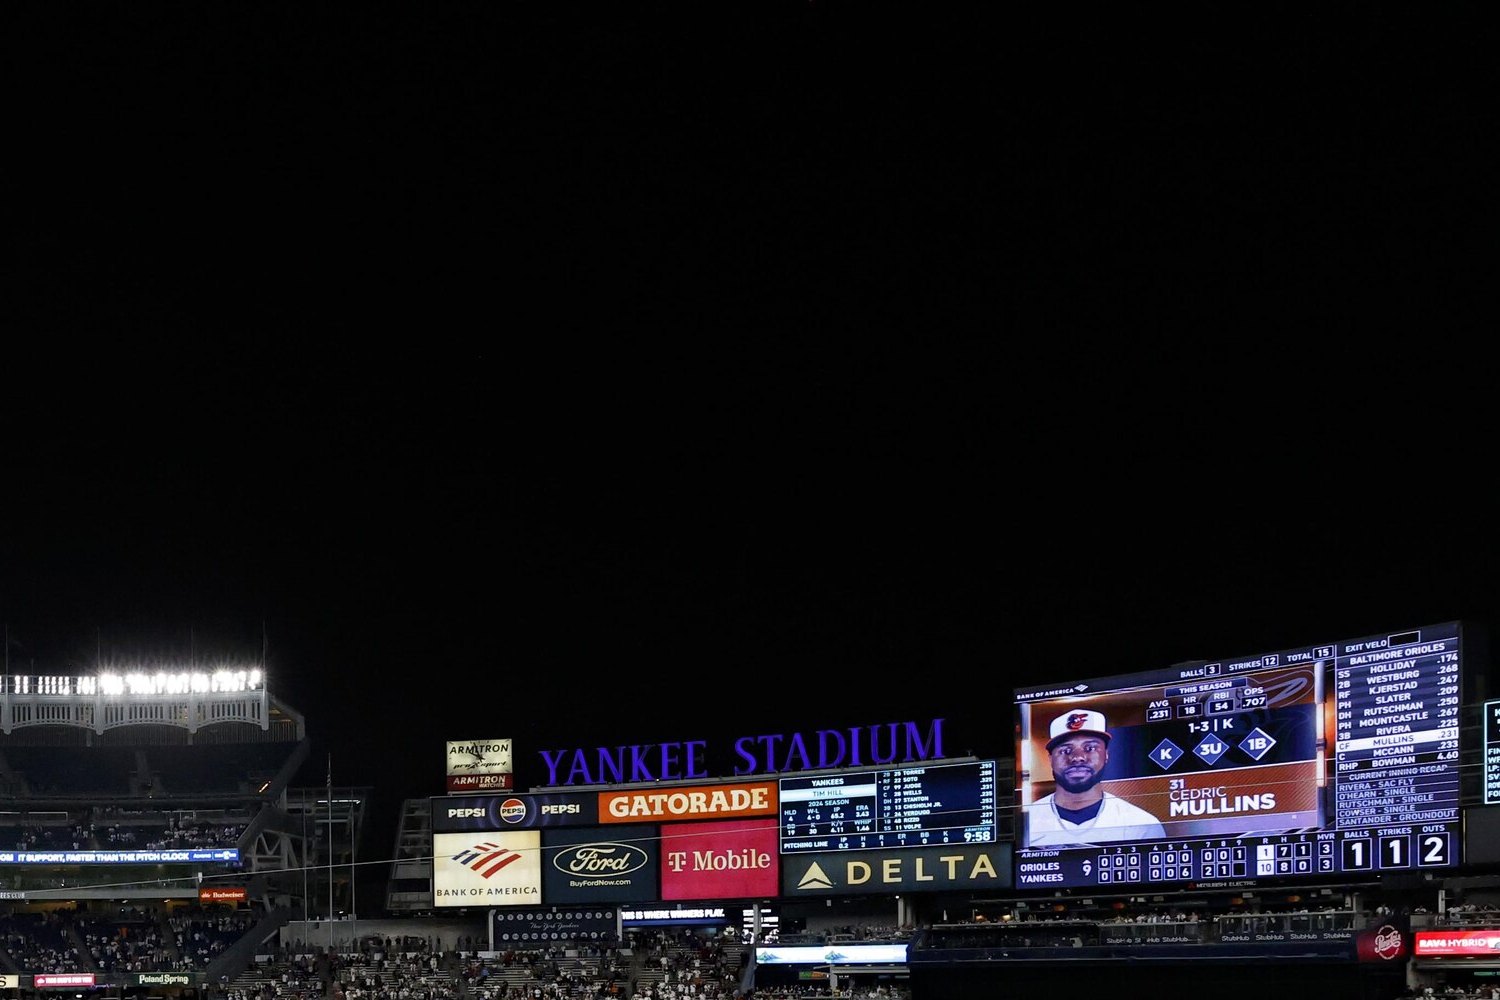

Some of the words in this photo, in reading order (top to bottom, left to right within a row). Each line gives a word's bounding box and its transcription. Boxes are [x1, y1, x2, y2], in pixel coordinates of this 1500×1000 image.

[1346, 643, 1364, 653] EXIT
[1365, 640, 1386, 649] VELO
[1350, 650, 1402, 665] BALTIMORE
[1405, 643, 1445, 657] ORIOLES
[1181, 669, 1203, 678] BALLS
[1209, 666, 1215, 674] 3
[1229, 660, 1261, 671] STRIKES
[1265, 657, 1275, 666] 12
[1287, 652, 1312, 662] TOTAL
[1318, 647, 1329, 658] 15
[1370, 660, 1416, 674] HOLLIDAY
[1437, 653, 1458, 663] .174
[1367, 671, 1419, 684] WESTBURG
[1437, 664, 1458, 674] .268
[1180, 686, 1200, 694] THIS
[1202, 681, 1232, 692] SEASON
[1369, 681, 1417, 695] KJERSTAD
[1437, 675, 1458, 685] .247
[1149, 700, 1169, 708] AVG
[1213, 691, 1229, 700] RBI
[1244, 687, 1264, 695] OPS
[1376, 693, 1411, 704] SLATER
[1437, 686, 1458, 696] .209
[1149, 709, 1169, 718] .231
[1185, 706, 1195, 715] 18
[1215, 701, 1228, 710] 54
[1242, 696, 1265, 708] .707
[1364, 701, 1423, 716] RUTSCHMAN
[1437, 697, 1458, 707] .250
[1359, 712, 1428, 727] MOUNTCASTLE
[1437, 708, 1458, 717] .267
[1376, 725, 1411, 736] RIVERA
[1437, 719, 1458, 728] .225
[538, 740, 707, 787] YANKEE
[734, 718, 947, 777] STADIUM
[1160, 748, 1172, 759] K
[1201, 743, 1221, 755] 3U
[1247, 737, 1266, 750] 1B
[1373, 746, 1414, 757] MCCANN
[1437, 740, 1458, 750] .233
[1372, 756, 1415, 767] BOWMAN
[1437, 751, 1458, 760] 4.60
[453, 776, 506, 785] ARMITRON
[811, 778, 844, 786] YANKEES
[1170, 779, 1185, 790] 31
[1170, 787, 1226, 801] CEDRIC
[501, 807, 525, 815] PEPSI
[541, 804, 580, 815] PEPSI
[609, 788, 768, 818] GATORADE
[1170, 794, 1276, 817] MULLINS
[448, 808, 485, 818] PEPSI
[963, 831, 990, 842] 9:58
[1344, 831, 1369, 839] BALLS
[1377, 827, 1412, 837] STRIKES
[1422, 824, 1445, 833] OUTS
[784, 841, 813, 849] PITCHING
[1351, 842, 1362, 866] 1
[1389, 840, 1401, 864] 1
[1424, 837, 1444, 862] 2
[570, 846, 631, 873] Ford
[668, 852, 687, 872] T
[692, 849, 770, 871] Mobile
[1020, 862, 1060, 872] ORIOLES
[847, 854, 997, 885] DELTA
[1020, 873, 1064, 883] YANKEES
[436, 889, 467, 897] BANK
[486, 887, 538, 895] AMERICA
[570, 879, 631, 888] BuyFordNow.com
[1419, 939, 1446, 948] RAV4
[1447, 938, 1485, 947] HYBRID
